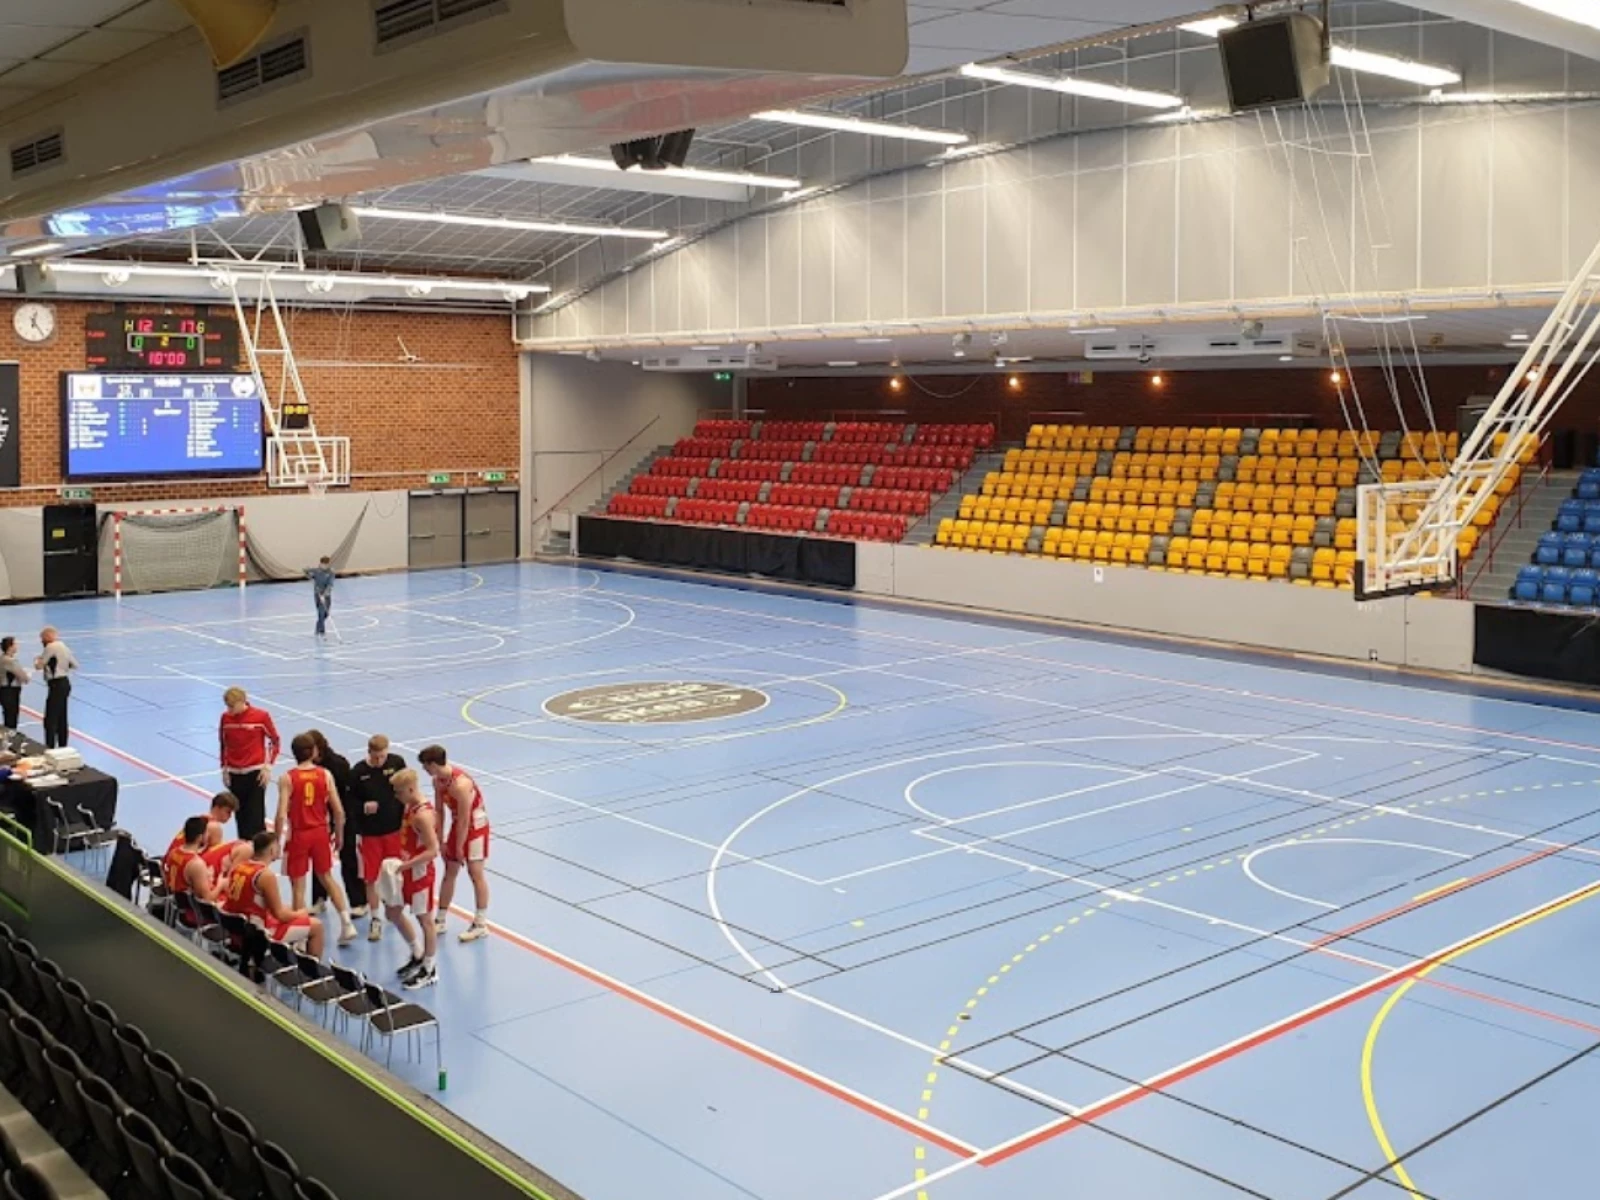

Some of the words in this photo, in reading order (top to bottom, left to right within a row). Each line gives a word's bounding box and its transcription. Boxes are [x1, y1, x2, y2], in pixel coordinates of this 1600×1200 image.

[138, 319, 153, 332] 12
[180, 319, 195, 333] 17
[134, 336, 144, 349] 0
[186, 336, 195, 350] 0
[305, 781, 315, 807] 9
